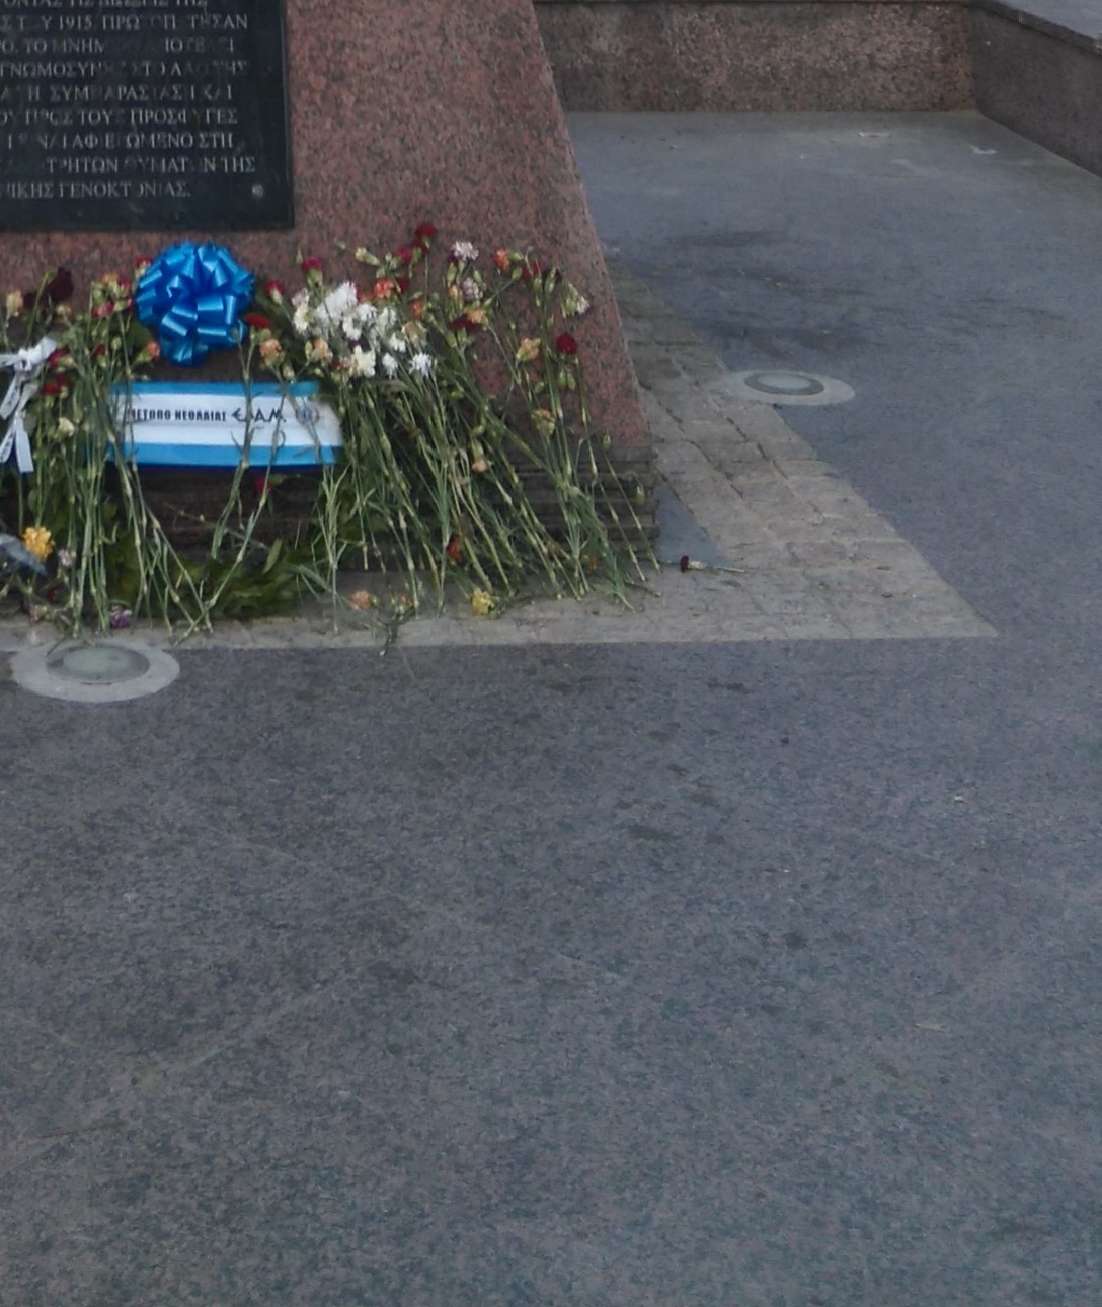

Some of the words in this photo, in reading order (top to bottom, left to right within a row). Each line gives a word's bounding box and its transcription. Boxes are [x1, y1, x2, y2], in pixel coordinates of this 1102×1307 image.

[16, 15, 53, 31] ΤΥ
[102, 13, 248, 31] ΠΡΩΟΠΤΗΣΑΝ
[25, 37, 48, 54] ΤΟ
[15, 85, 40, 102] Η
[199, 132, 234, 149] ΣΤΗ
[124, 156, 216, 174] ΘΥΜΑΤΝ
[220, 155, 256, 174] ΤΗΣ
